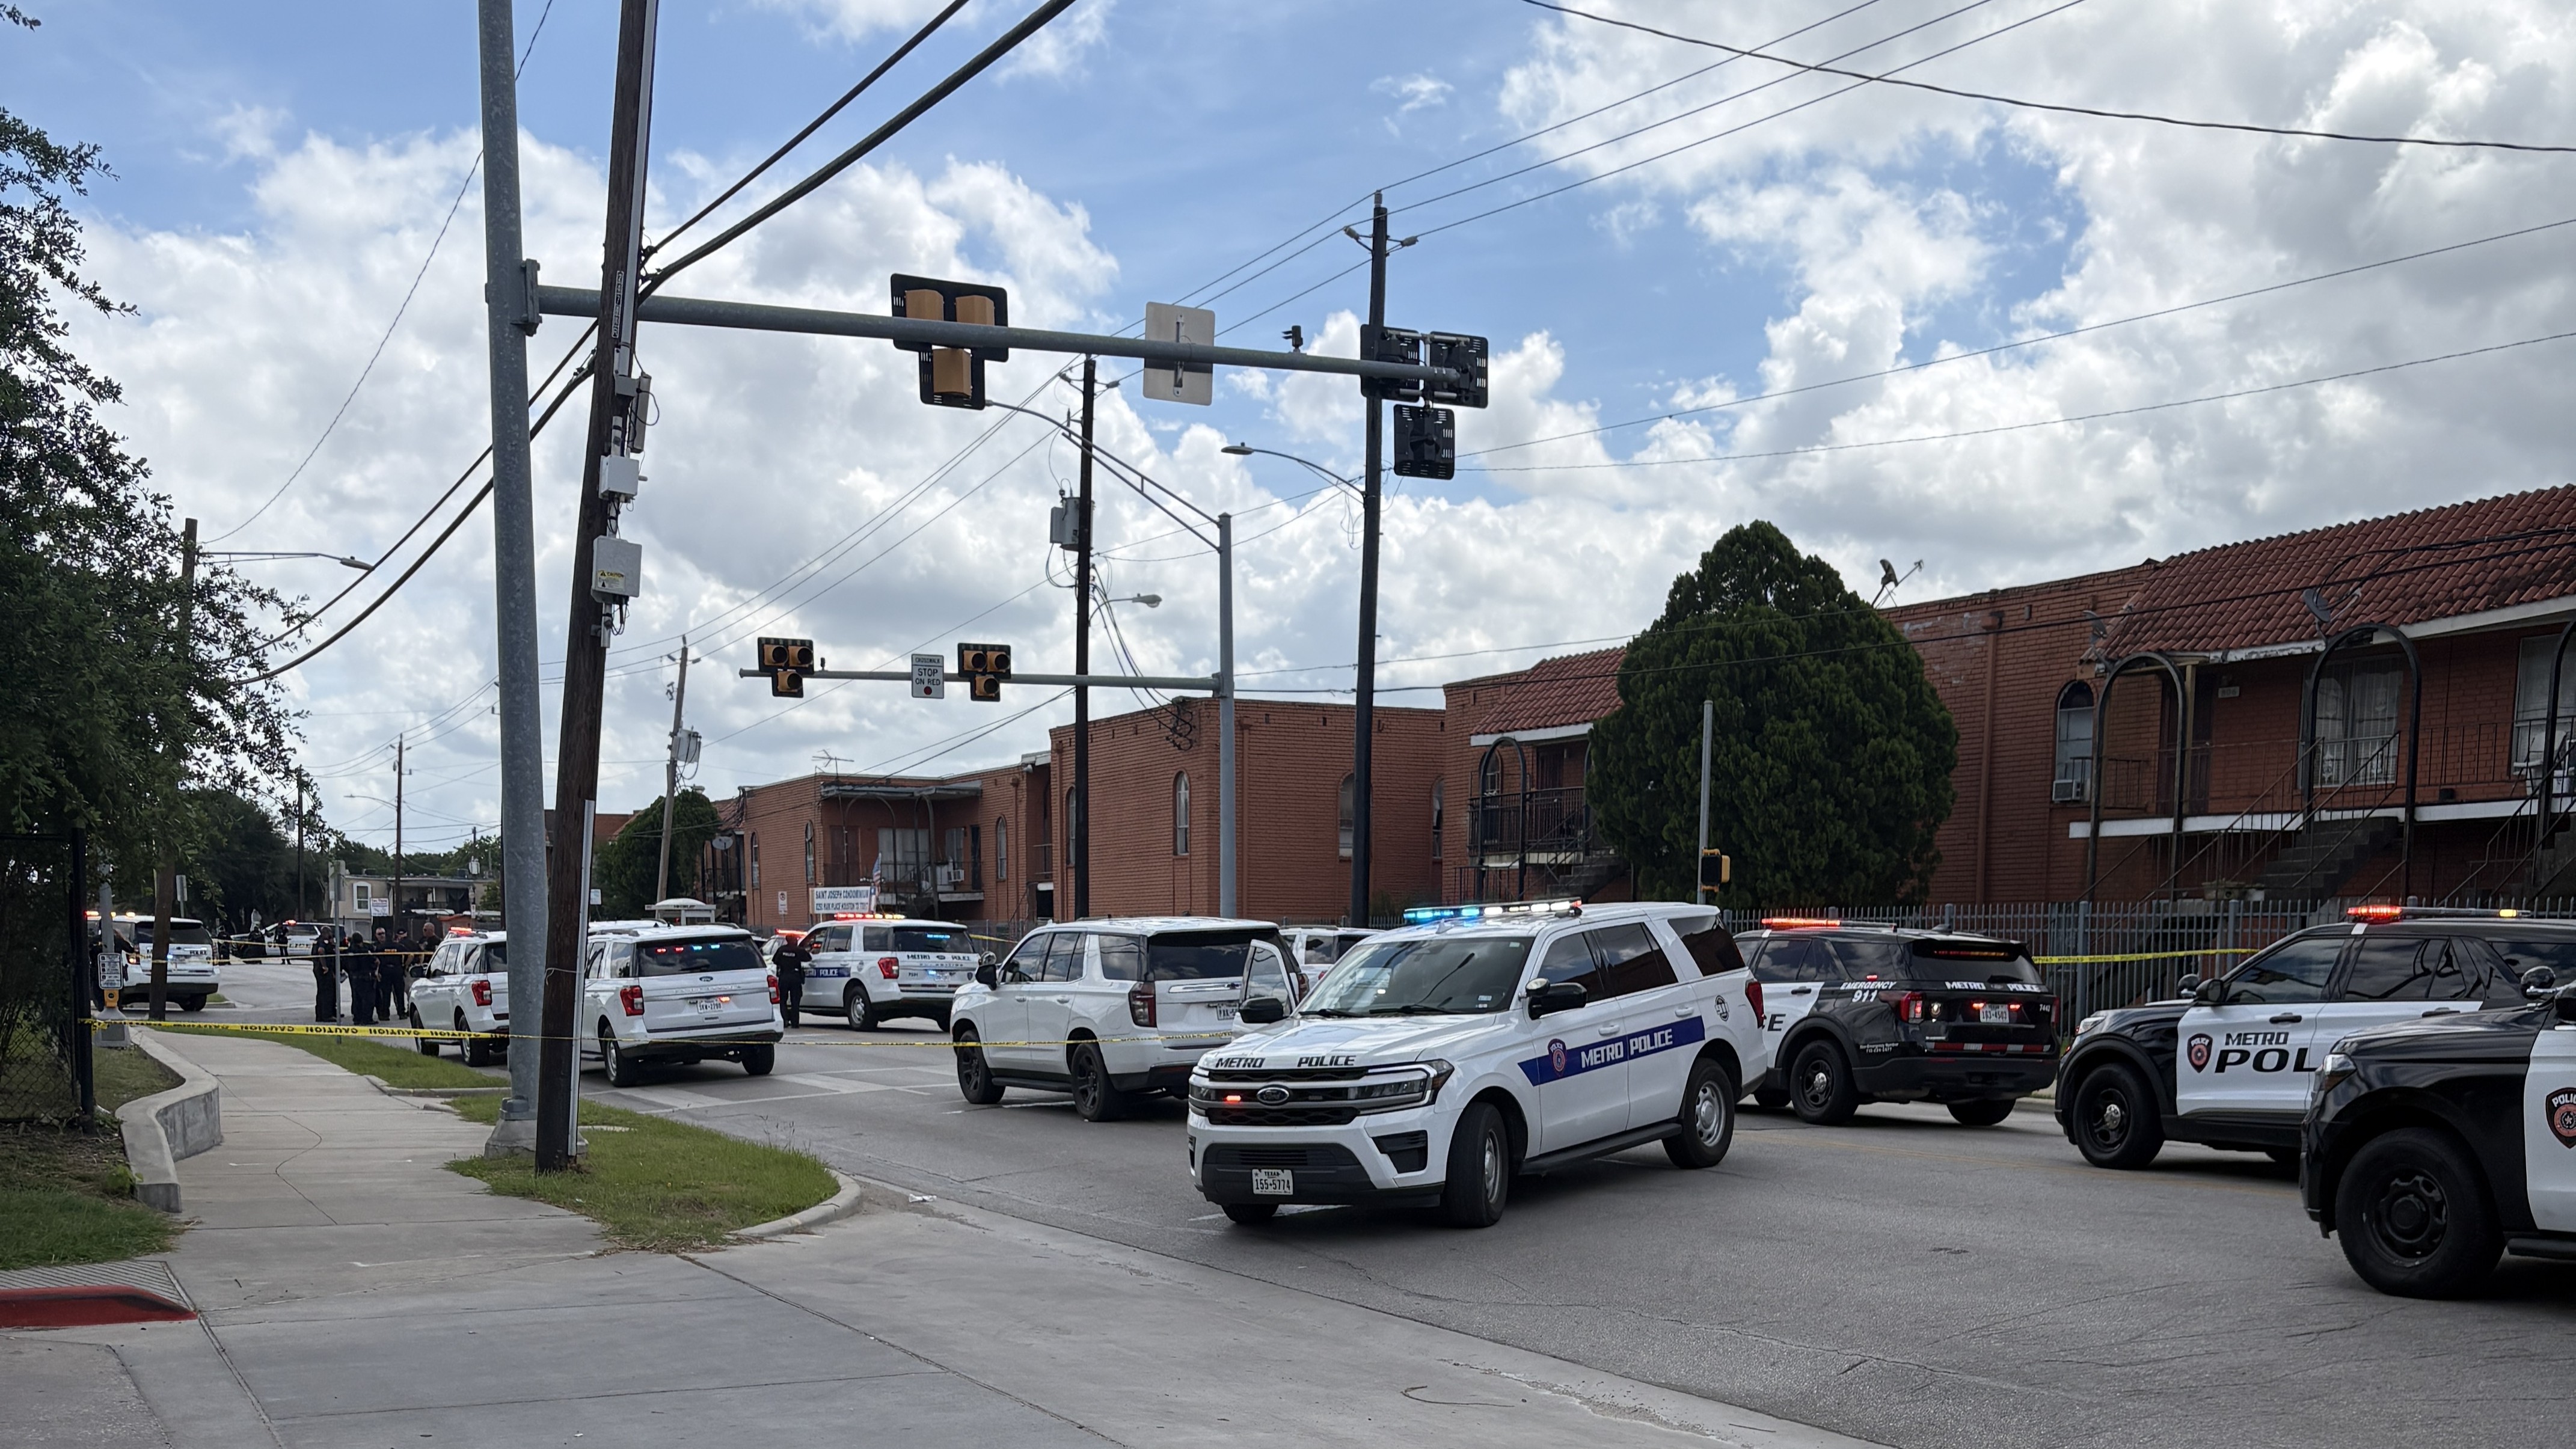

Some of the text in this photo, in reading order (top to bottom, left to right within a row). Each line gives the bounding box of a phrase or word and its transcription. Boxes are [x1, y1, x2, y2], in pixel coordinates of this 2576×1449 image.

[918, 668, 938, 677] STOP
[815, 890, 827, 899] SAINT
[827, 890, 842, 899] JOSEPH
[1840, 981, 1897, 990] EMERGENCY
[1945, 981, 2041, 993] METRO POLICE
[1852, 990, 1877, 1002] 911
[2225, 1032, 2289, 1046] METRO
[1581, 1029, 1673, 1068] METRO POLICE
[1215, 1055, 1357, 1068] METRO POLICE
